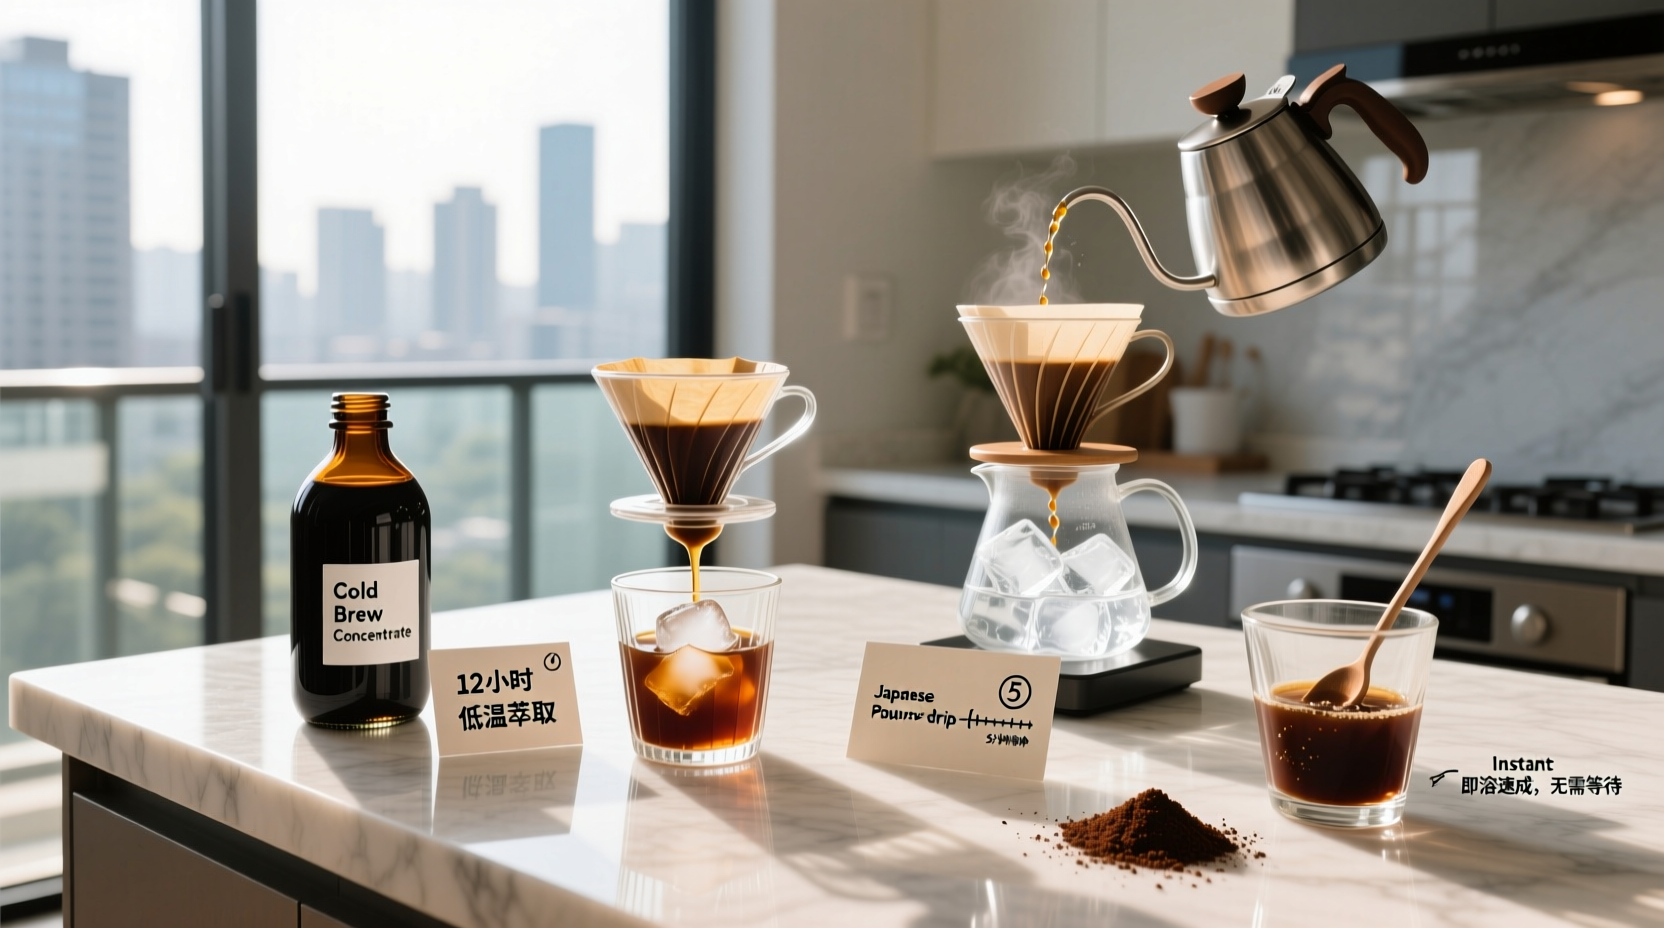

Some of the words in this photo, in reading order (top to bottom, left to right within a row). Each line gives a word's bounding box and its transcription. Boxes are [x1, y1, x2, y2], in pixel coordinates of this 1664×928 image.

[333, 580, 378, 600] Cold
[334, 605, 383, 623] Brew
[333, 626, 412, 642] Concentrate
[457, 667, 533, 695] 12小时
[458, 700, 557, 732] 低温萃取
[927, 708, 957, 729] drip
